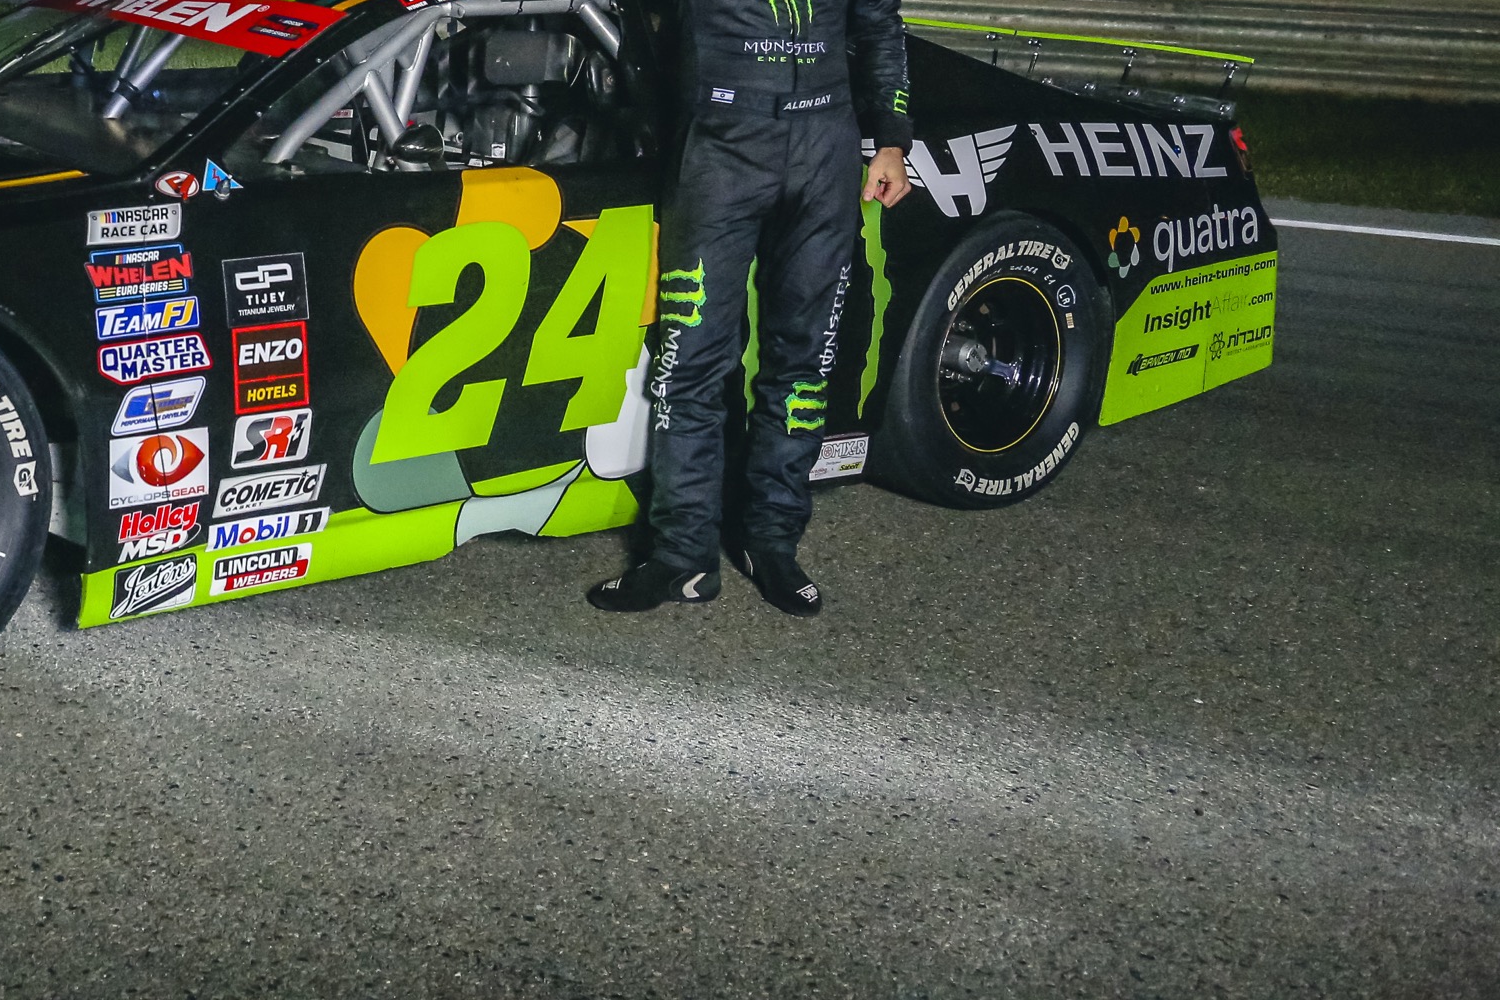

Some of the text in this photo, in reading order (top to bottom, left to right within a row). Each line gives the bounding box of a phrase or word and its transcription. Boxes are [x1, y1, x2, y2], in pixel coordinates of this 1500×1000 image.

[406, 0, 428, 11] WINNER
[783, 94, 832, 111] ALON DAY
[1028, 123, 1227, 178] HEINZ
[101, 223, 168, 238] RACE CAR
[117, 208, 168, 223] NASCAR
[1153, 203, 1258, 272] quatra
[86, 253, 192, 287] WHELEN
[126, 250, 159, 263] NASCAR
[116, 281, 168, 297] EURO SERIES
[947, 240, 1054, 311] GENERAL TIRE
[1150, 258, 1276, 295] www.heinz-tuning.com
[238, 303, 295, 317] TITANIUM JEWELRY
[245, 291, 286, 306] TIJEY
[1143, 291, 1273, 334] InsightAffair.com
[369, 204, 654, 465] 24
[102, 337, 199, 371] QUARTER
[121, 353, 205, 381] MASTER
[239, 338, 302, 366] ENZO
[247, 383, 297, 402] HOTELS
[974, 421, 1080, 495] GENERAL TIRE
[220, 472, 319, 507] COMETIC
[118, 501, 200, 540] Holley
[225, 502, 263, 512] GASKET
[118, 530, 188, 563] MSD
[213, 516, 290, 549] Mobil
[218, 550, 295, 578] LINCOLN
[233, 566, 298, 589] WELDERS
[110, 558, 197, 619] Jostens
